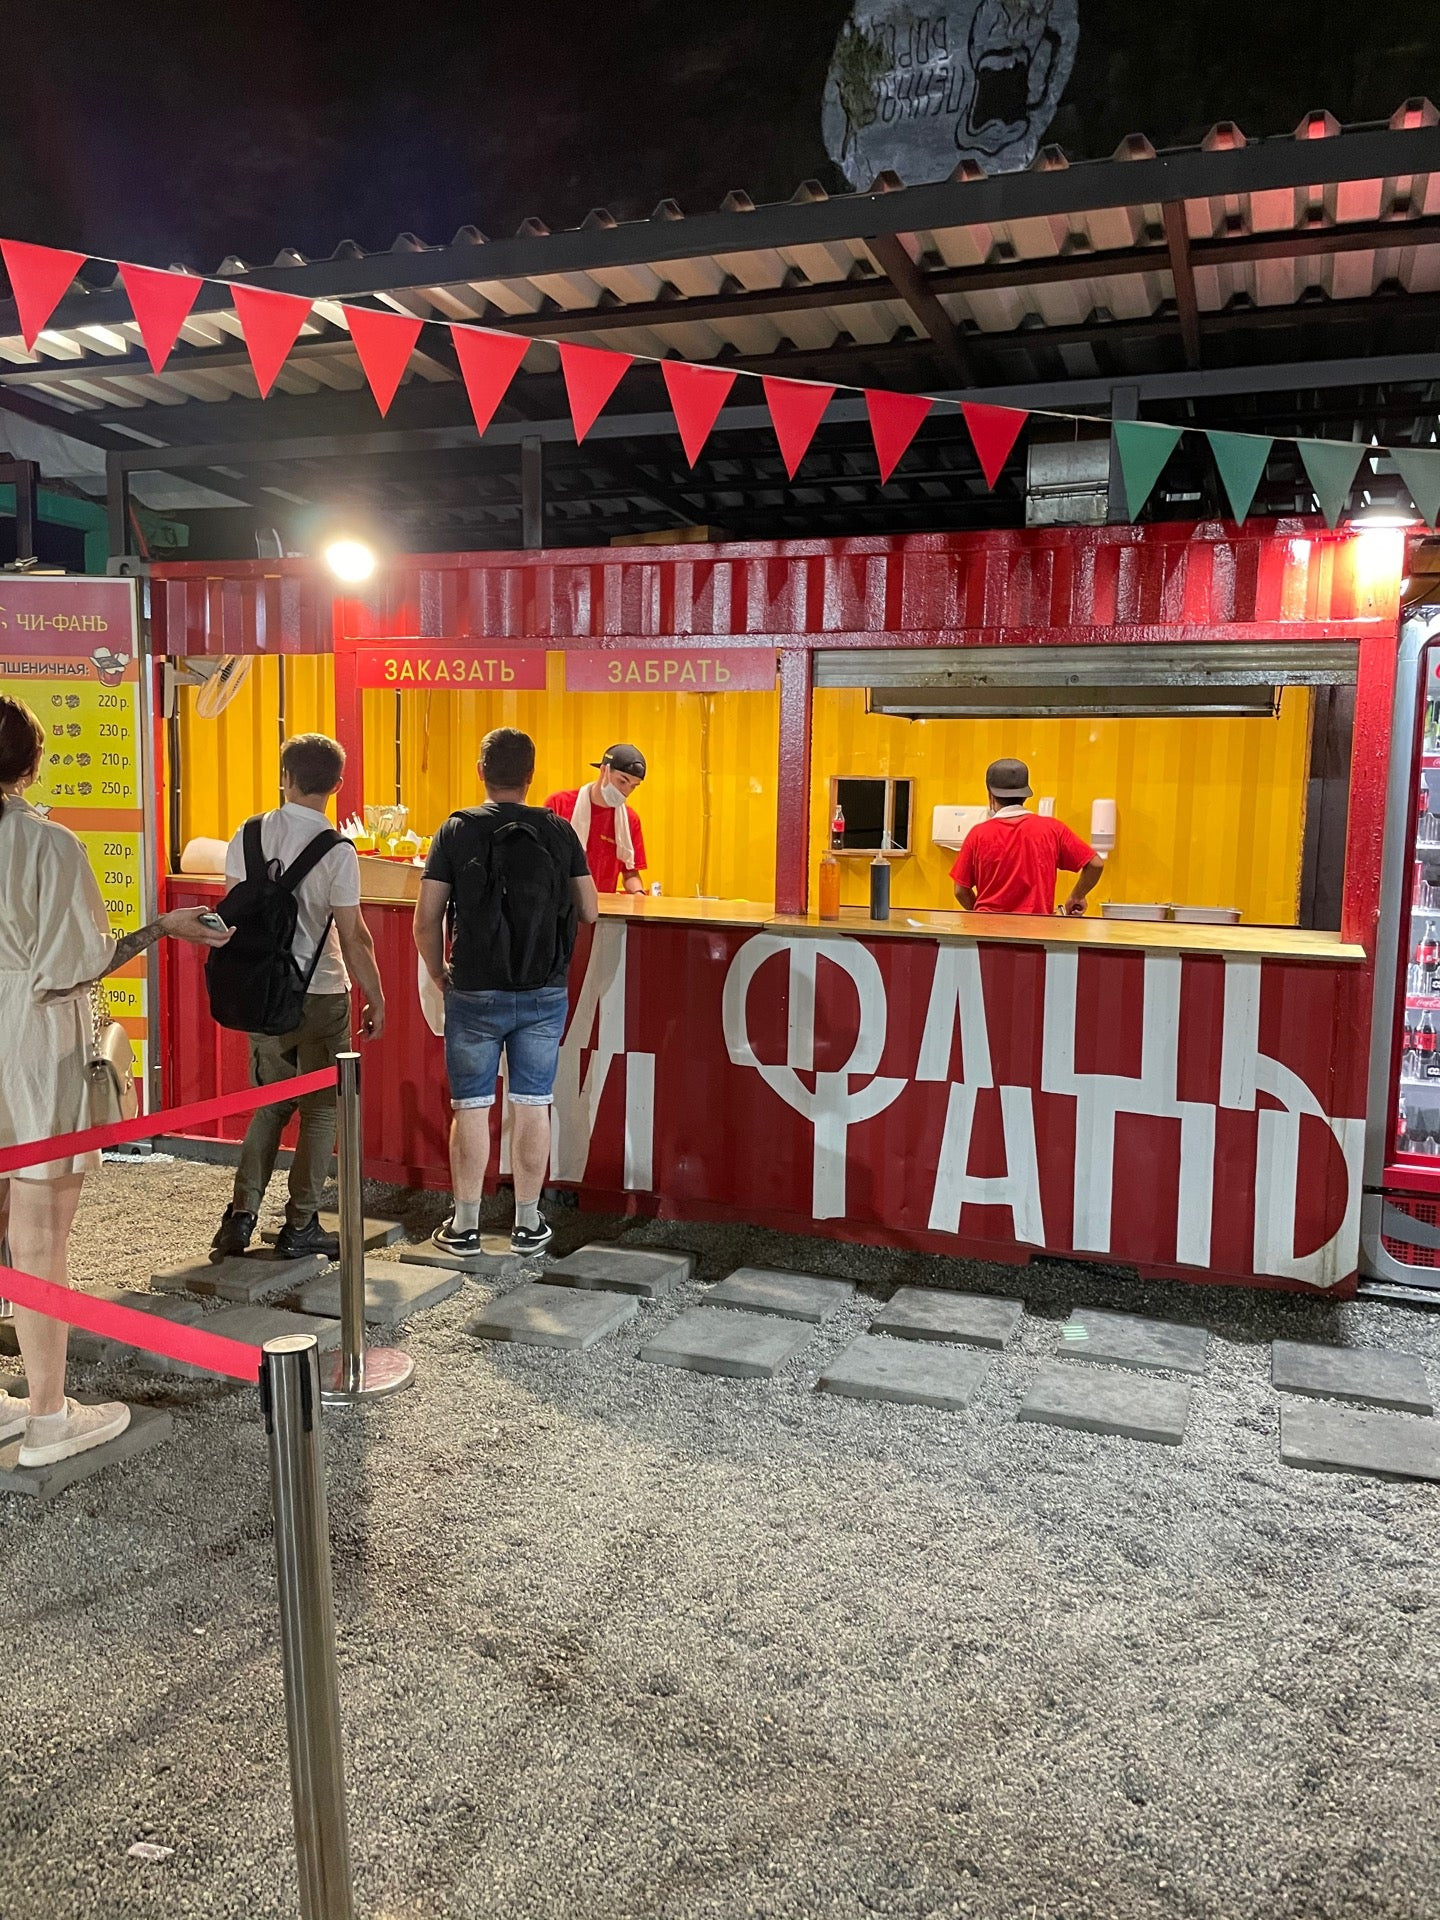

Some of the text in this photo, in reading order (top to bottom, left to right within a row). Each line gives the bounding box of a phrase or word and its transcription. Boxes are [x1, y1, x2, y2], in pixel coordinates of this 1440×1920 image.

[16, 613, 108, 632] ЧИ-ФАНЬ
[384, 659, 515, 682] ЗАКАЗАТЬ
[608, 660, 731, 683] ЗАБРАТЬ
[98, 694, 118, 707] 220
[99, 724, 118, 736] 230
[102, 753, 119, 766] 210
[102, 782, 120, 794] 250
[103, 843, 122, 856] 220
[104, 872, 123, 884] 230
[104, 900, 124, 912] 200
[111, 928, 125, 940] 50
[108, 990, 126, 1003] 190
[722, 929, 1366, 1289] ФАНЬ
